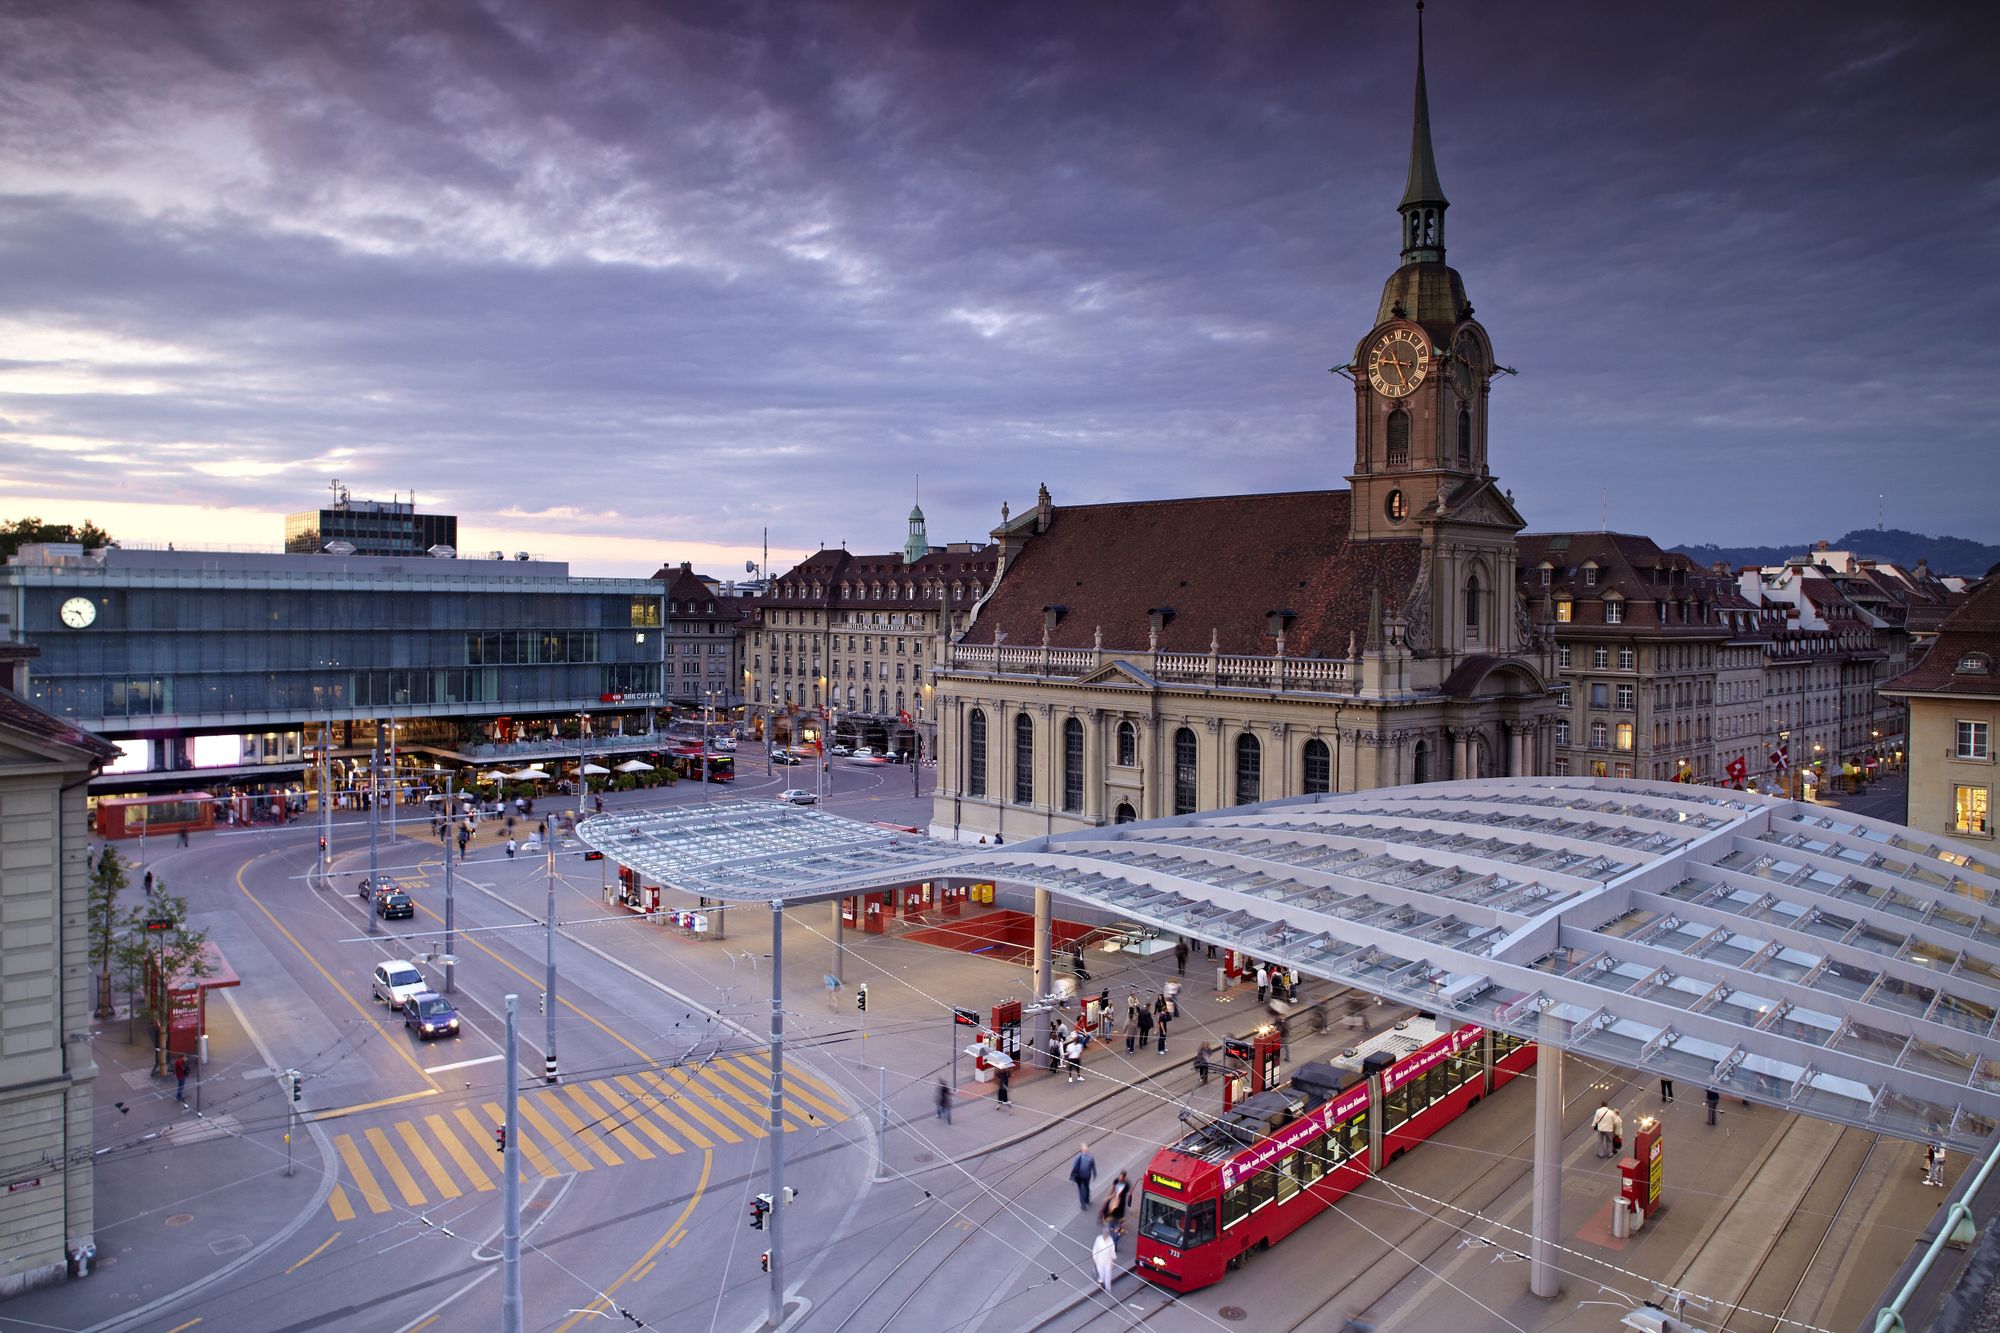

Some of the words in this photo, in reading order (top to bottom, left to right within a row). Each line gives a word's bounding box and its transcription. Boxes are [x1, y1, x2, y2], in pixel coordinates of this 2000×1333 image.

[1337, 1104, 1347, 1116] Blick
[1239, 1161, 1251, 1173] Blick
[1251, 1158, 1259, 1167] am
[1260, 1146, 1276, 1161] Abend.
